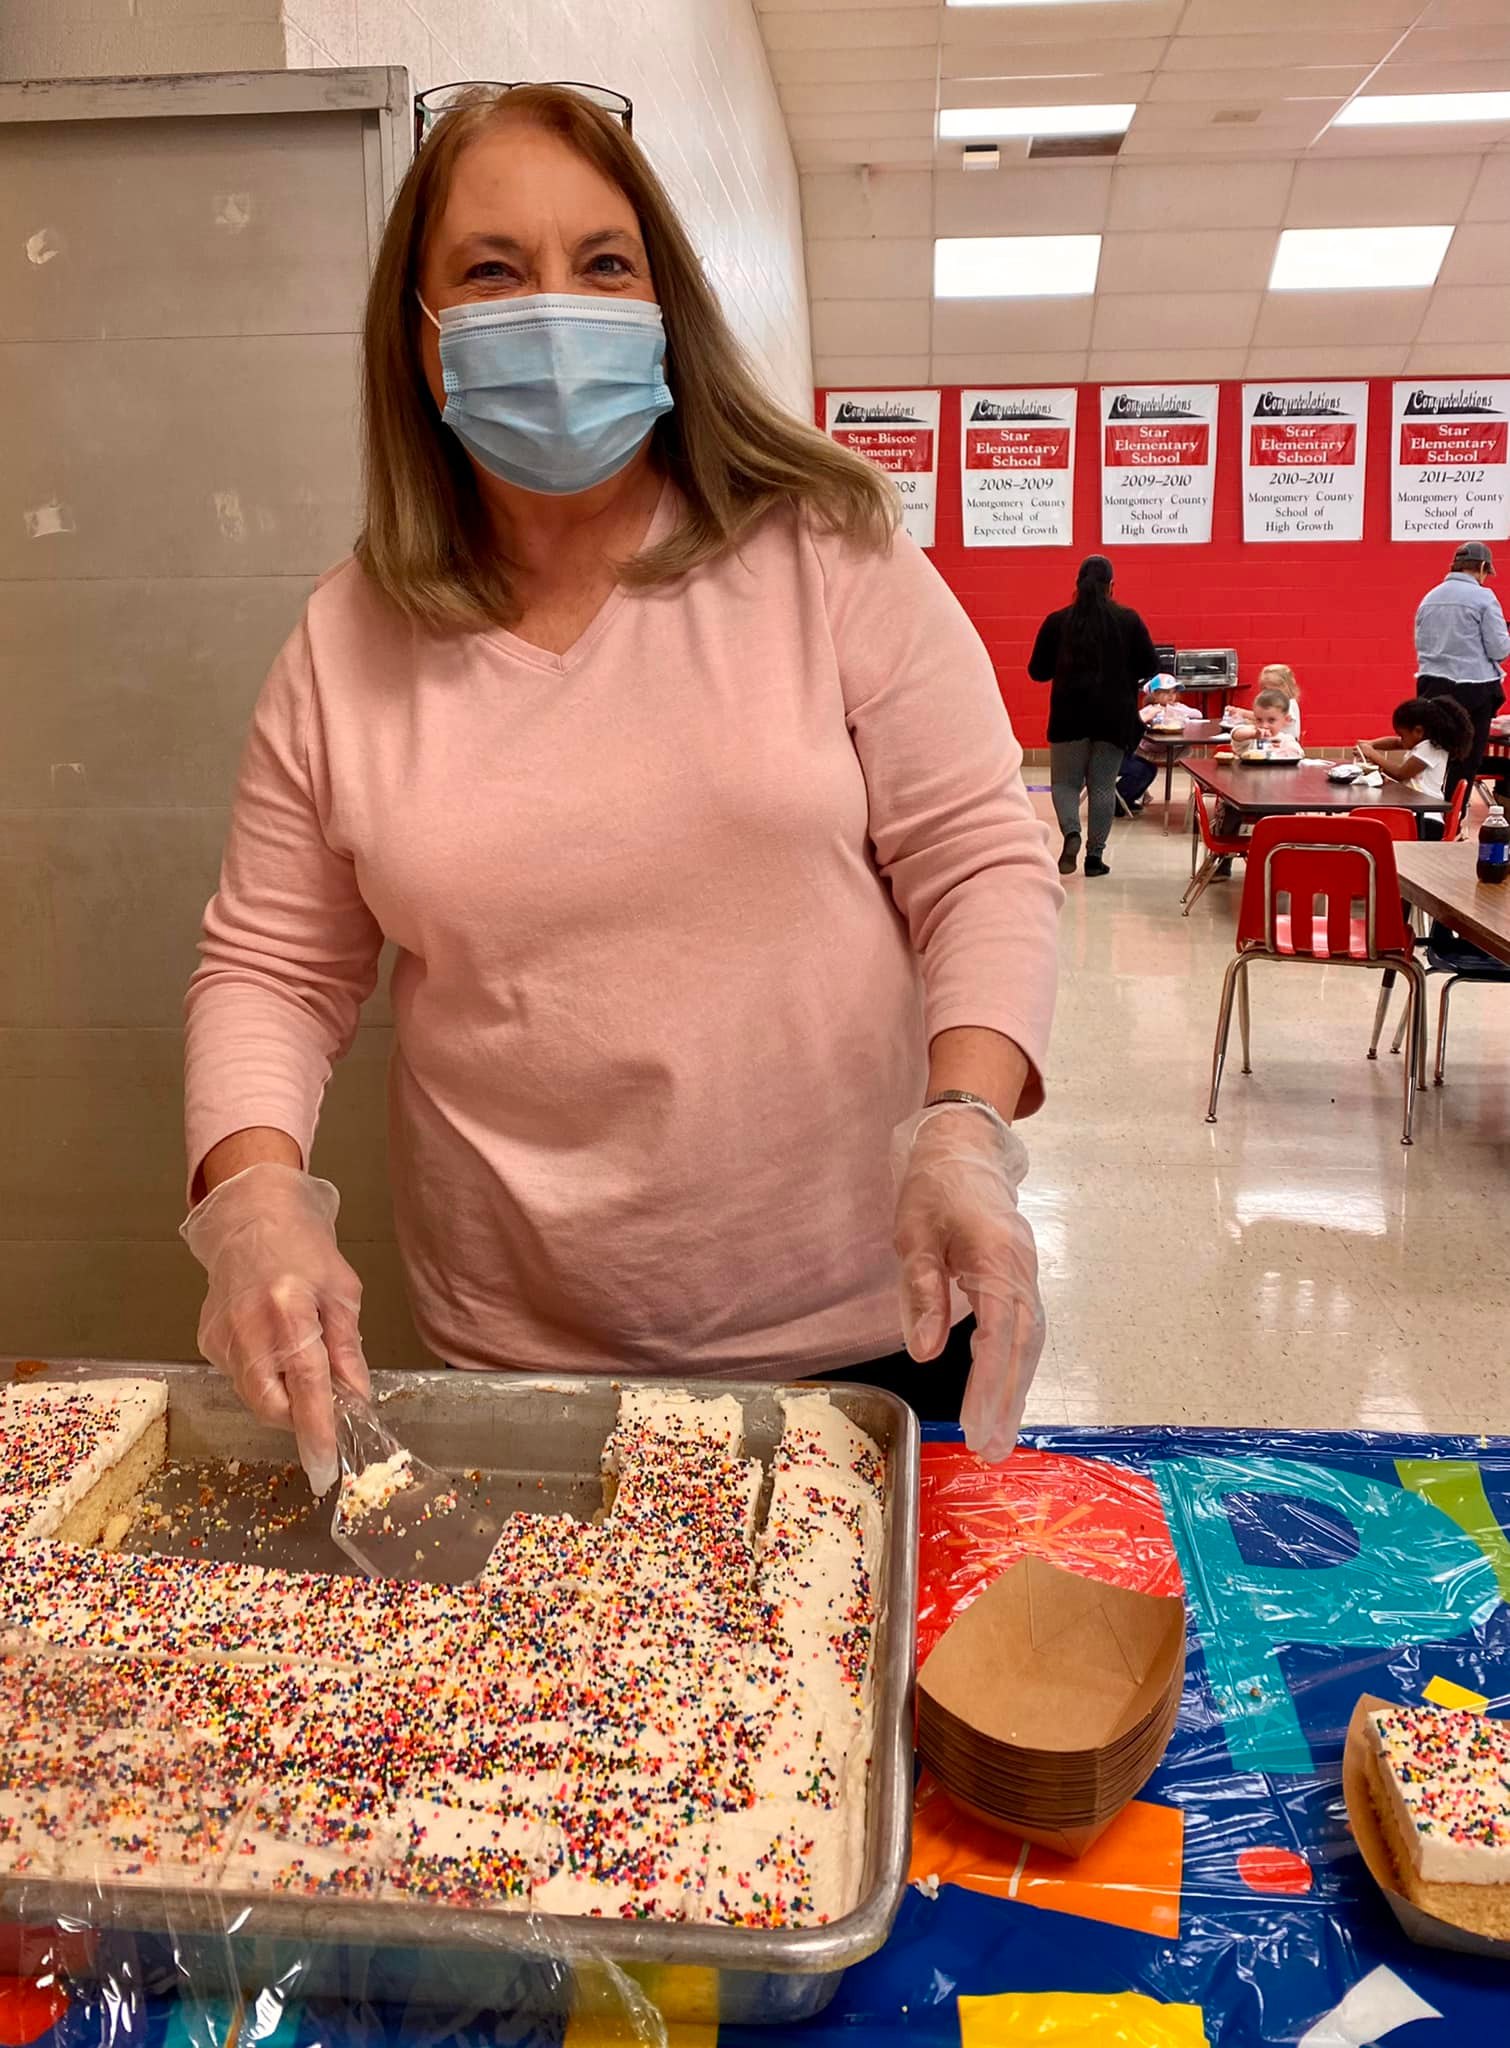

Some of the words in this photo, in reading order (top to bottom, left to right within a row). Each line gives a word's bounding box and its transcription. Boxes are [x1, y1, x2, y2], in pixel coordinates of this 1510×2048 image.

[1117, 393, 1192, 417] Congratulations
[1263, 391, 1341, 415] Congratulations
[1413, 388, 1493, 414] Congratulations
[980, 399, 1052, 420] Congratulations
[1000, 429, 1030, 441] Star
[1139, 426, 1169, 438] Star
[1286, 425, 1316, 437] Star
[1439, 424, 1470, 436] Star
[848, 433, 917, 444] Star-Biscoe
[1410, 437, 1496, 451] Elementary
[976, 442, 1059, 456] Elementary
[1115, 439, 1198, 452] Elementary
[1261, 438, 1345, 452] Elementary
[992, 455, 1041, 467] School
[1131, 452, 1180, 463] School
[1277, 451, 1327, 463] School
[1427, 450, 1478, 462] School
[1104, 496, 1164, 507] Montgomery
[1171, 494, 1208, 505] County
[1248, 492, 1309, 504] Montgomery
[1316, 490, 1354, 502] County
[1398, 492, 1458, 504] Montgomery
[1466, 491, 1504, 503] County
[902, 503, 930, 511] ounty
[967, 498, 1024, 509] Montgomery
[1031, 498, 1066, 508] County
[992, 512, 1023, 522] School
[1029, 512, 1040, 521] of
[1130, 510, 1162, 520] School
[1169, 510, 1179, 520] of
[1275, 506, 1308, 517] School
[1314, 506, 1325, 516] of
[1425, 507, 1457, 517] School
[1464, 507, 1474, 517] of
[974, 525, 1016, 537] Expected
[1022, 525, 1058, 535] Growth
[1121, 524, 1145, 536] High
[1151, 524, 1188, 534] Growth
[1265, 521, 1290, 533] High
[1296, 520, 1334, 531] Growth
[1404, 520, 1449, 532] Expected
[1456, 520, 1494, 530] Growth
